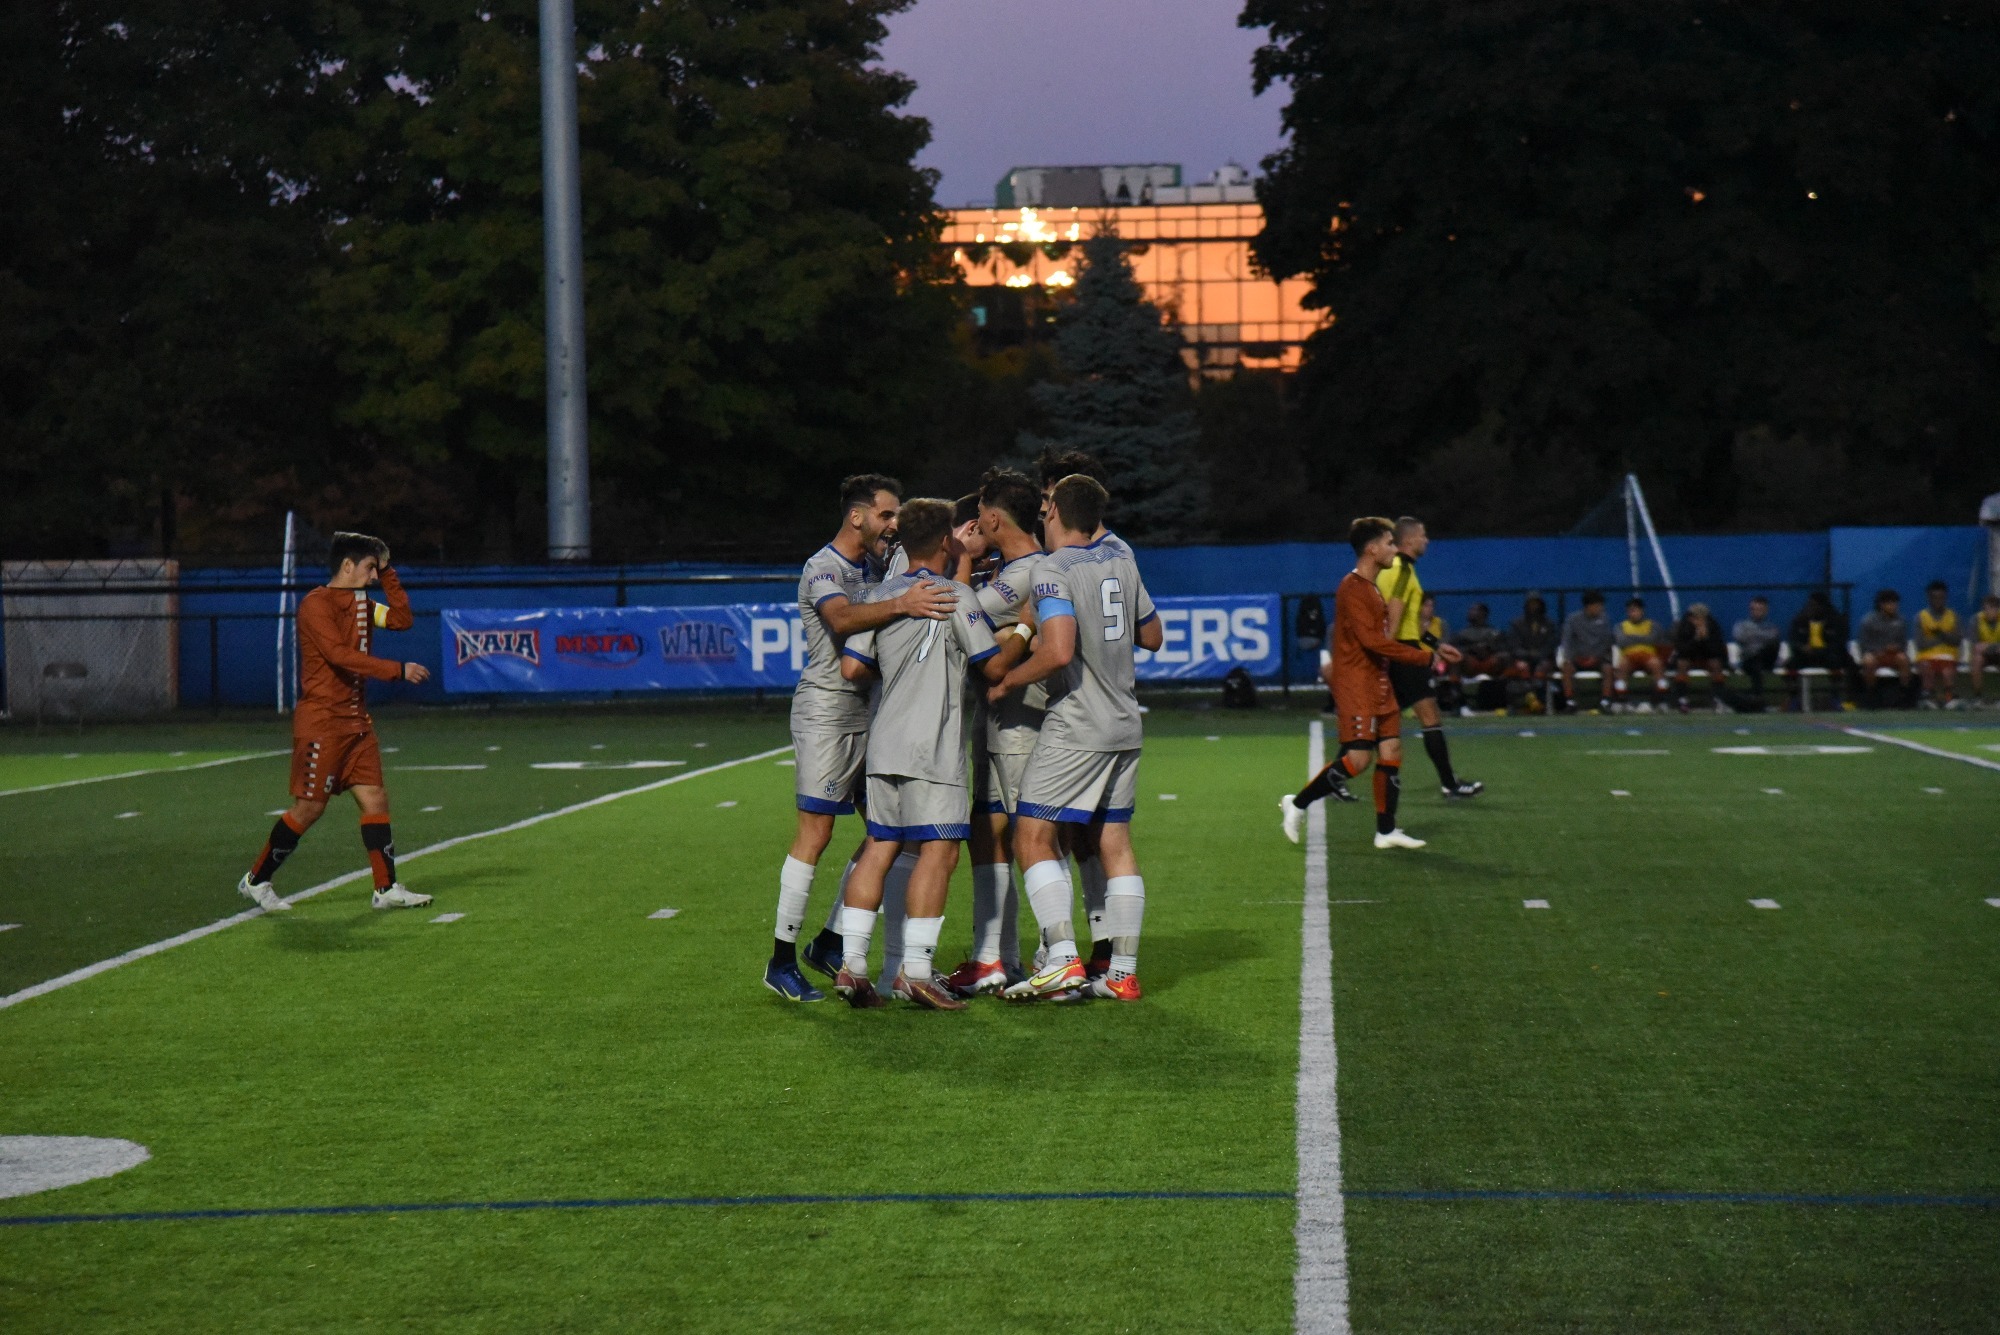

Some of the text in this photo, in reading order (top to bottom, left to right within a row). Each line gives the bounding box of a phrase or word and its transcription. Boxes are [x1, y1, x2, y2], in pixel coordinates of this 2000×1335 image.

[1100, 577, 1125, 642] 5
[457, 630, 540, 666] NAIA
[660, 622, 736, 659] WHAC
[324, 775, 335, 793] 5
